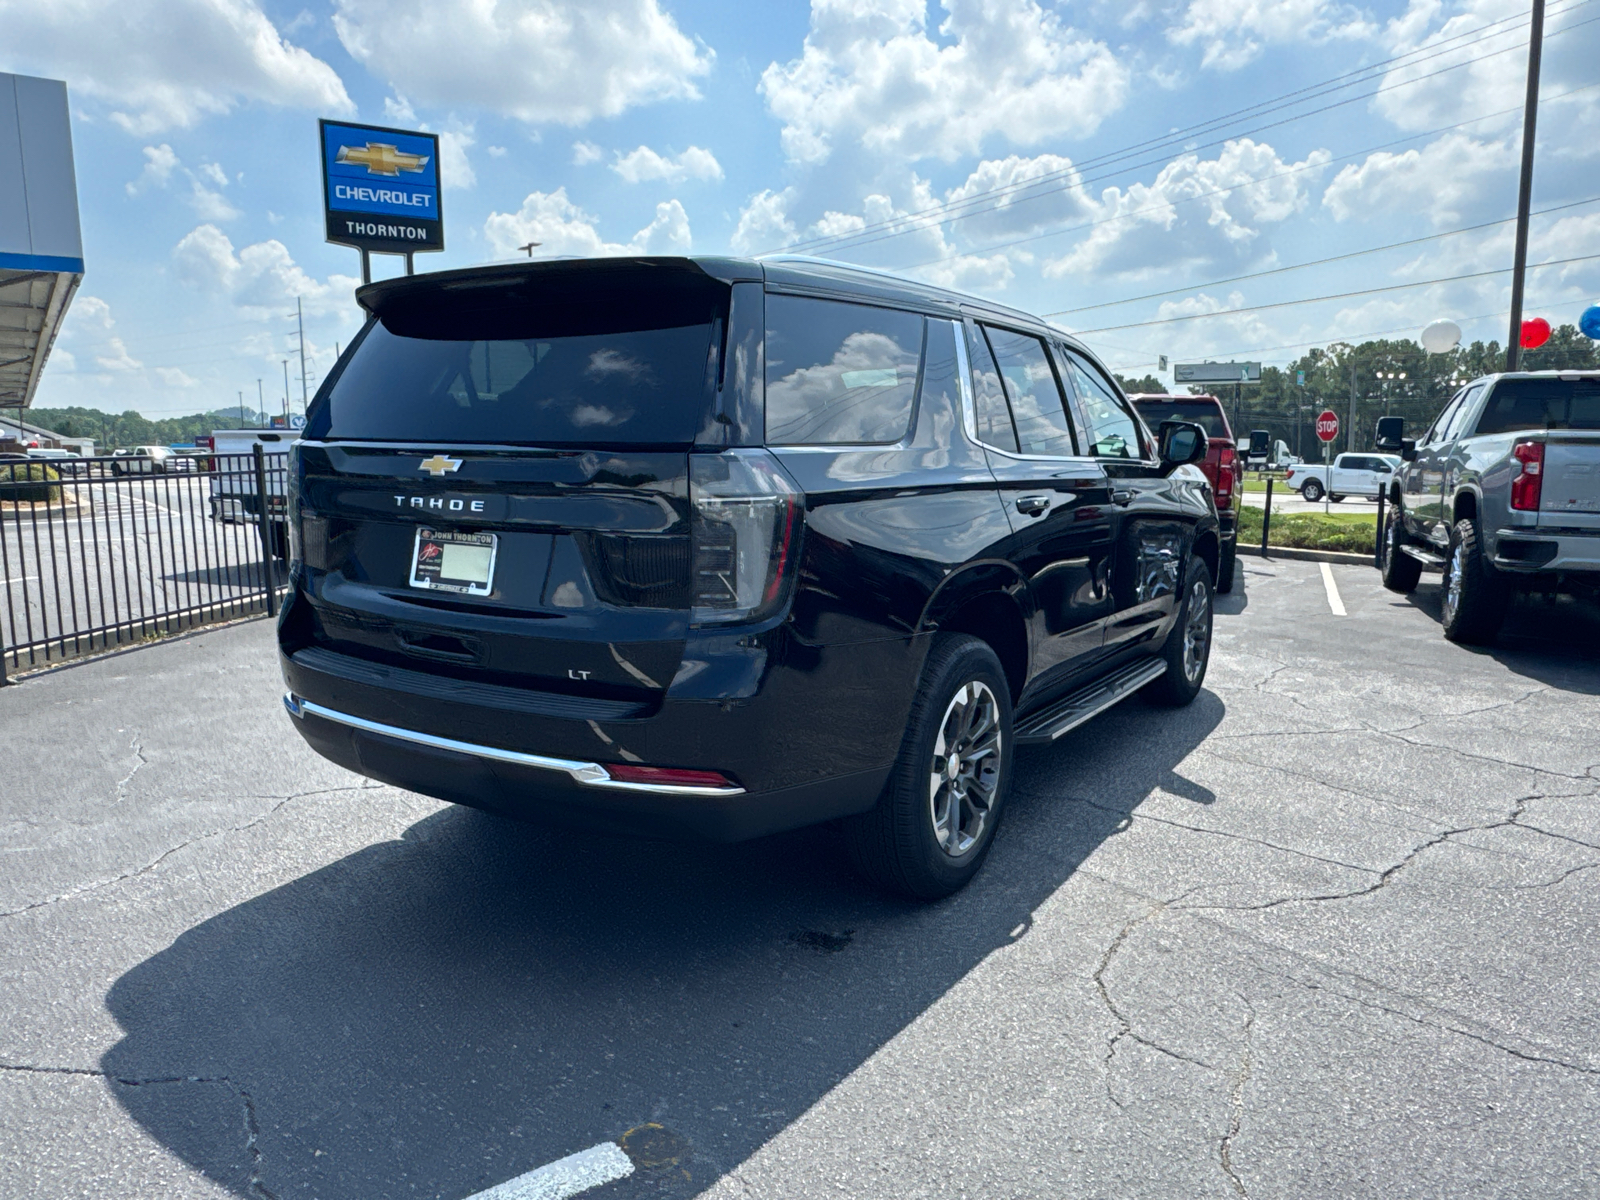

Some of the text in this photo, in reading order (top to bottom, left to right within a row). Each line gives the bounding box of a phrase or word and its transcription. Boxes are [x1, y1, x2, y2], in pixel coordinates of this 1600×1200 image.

[335, 185, 432, 207] CHEVROLET
[346, 221, 427, 240] THORNTON
[1318, 421, 1337, 432] STOP
[394, 496, 485, 511] TAHOE
[434, 531, 452, 540] JOHN
[568, 669, 591, 680] LT
